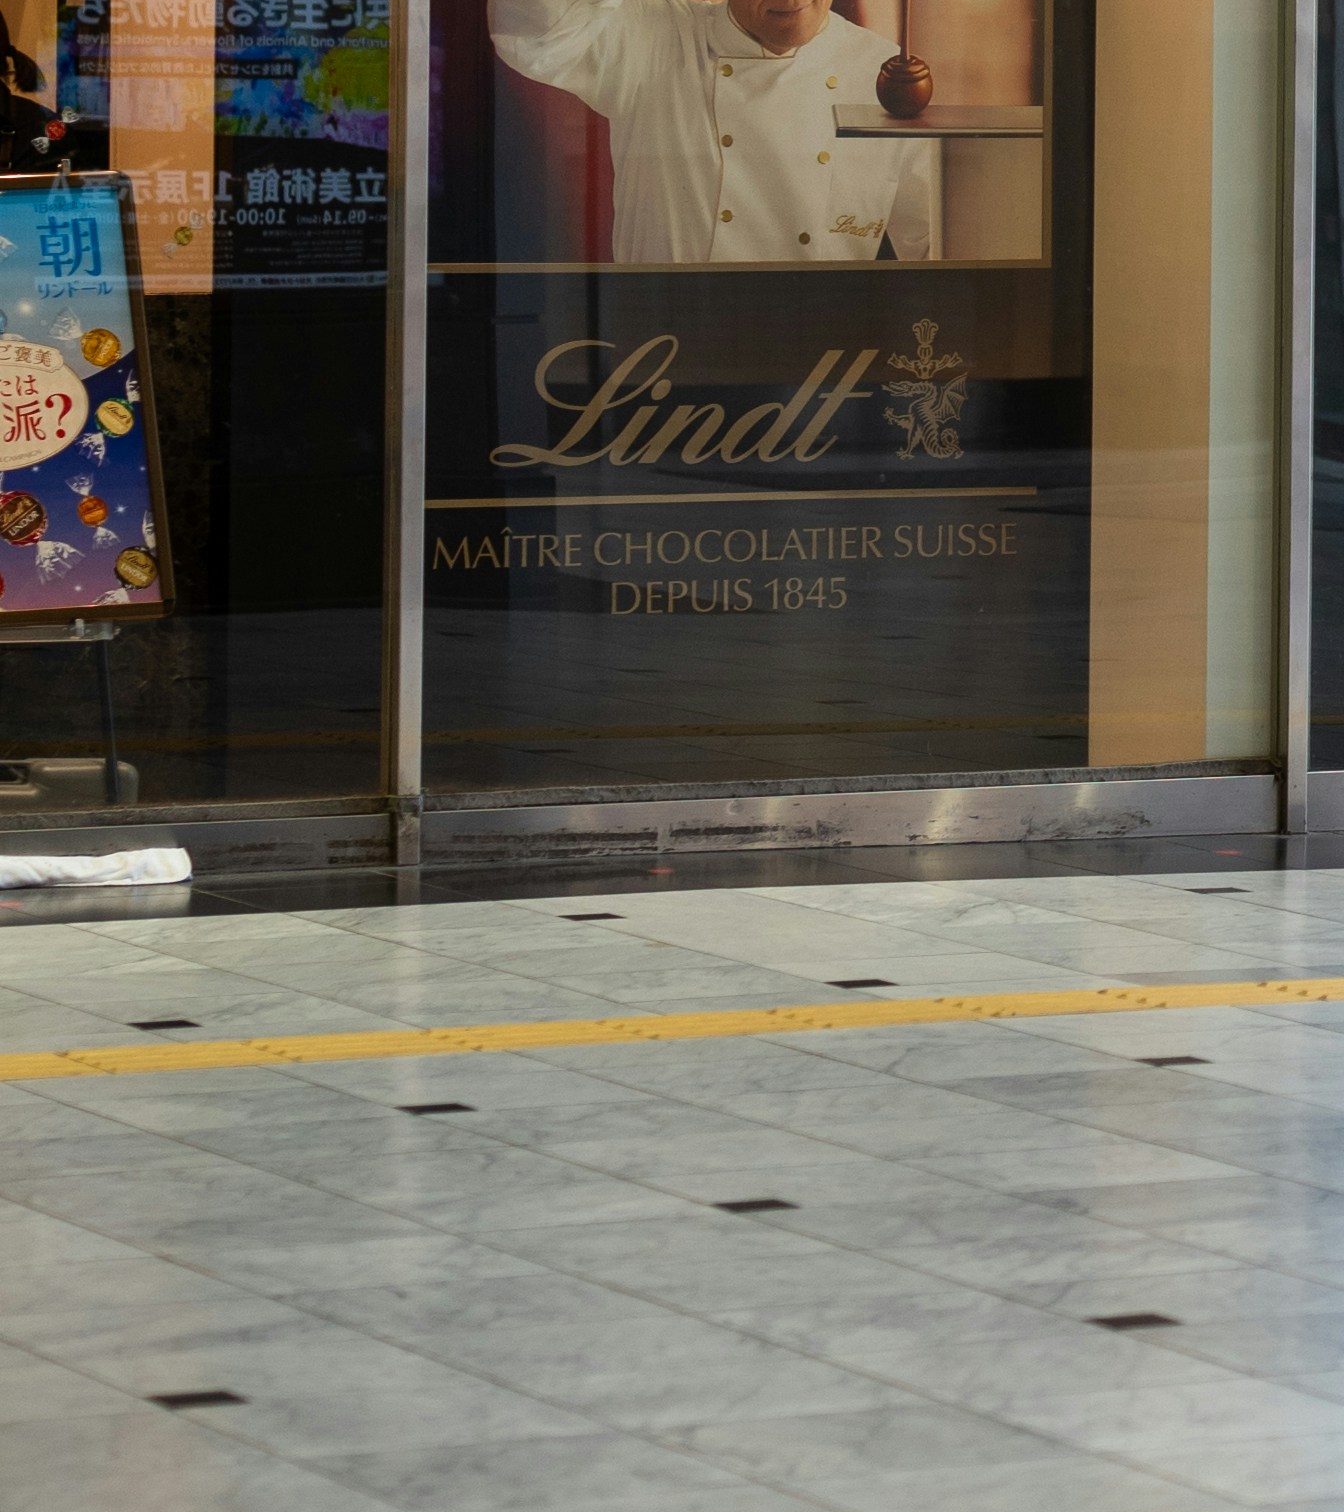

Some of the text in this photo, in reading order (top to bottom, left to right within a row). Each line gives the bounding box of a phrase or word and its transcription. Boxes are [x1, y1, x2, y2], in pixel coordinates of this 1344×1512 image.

[36, 215, 103, 278] 朝
[37, 281, 113, 299] リンドール
[489, 334, 879, 468] Lindt
[432, 522, 1018, 571] MAÎTRE CHOCOLATIER SUISSE
[610, 576, 848, 617] DEPUIS 1845
